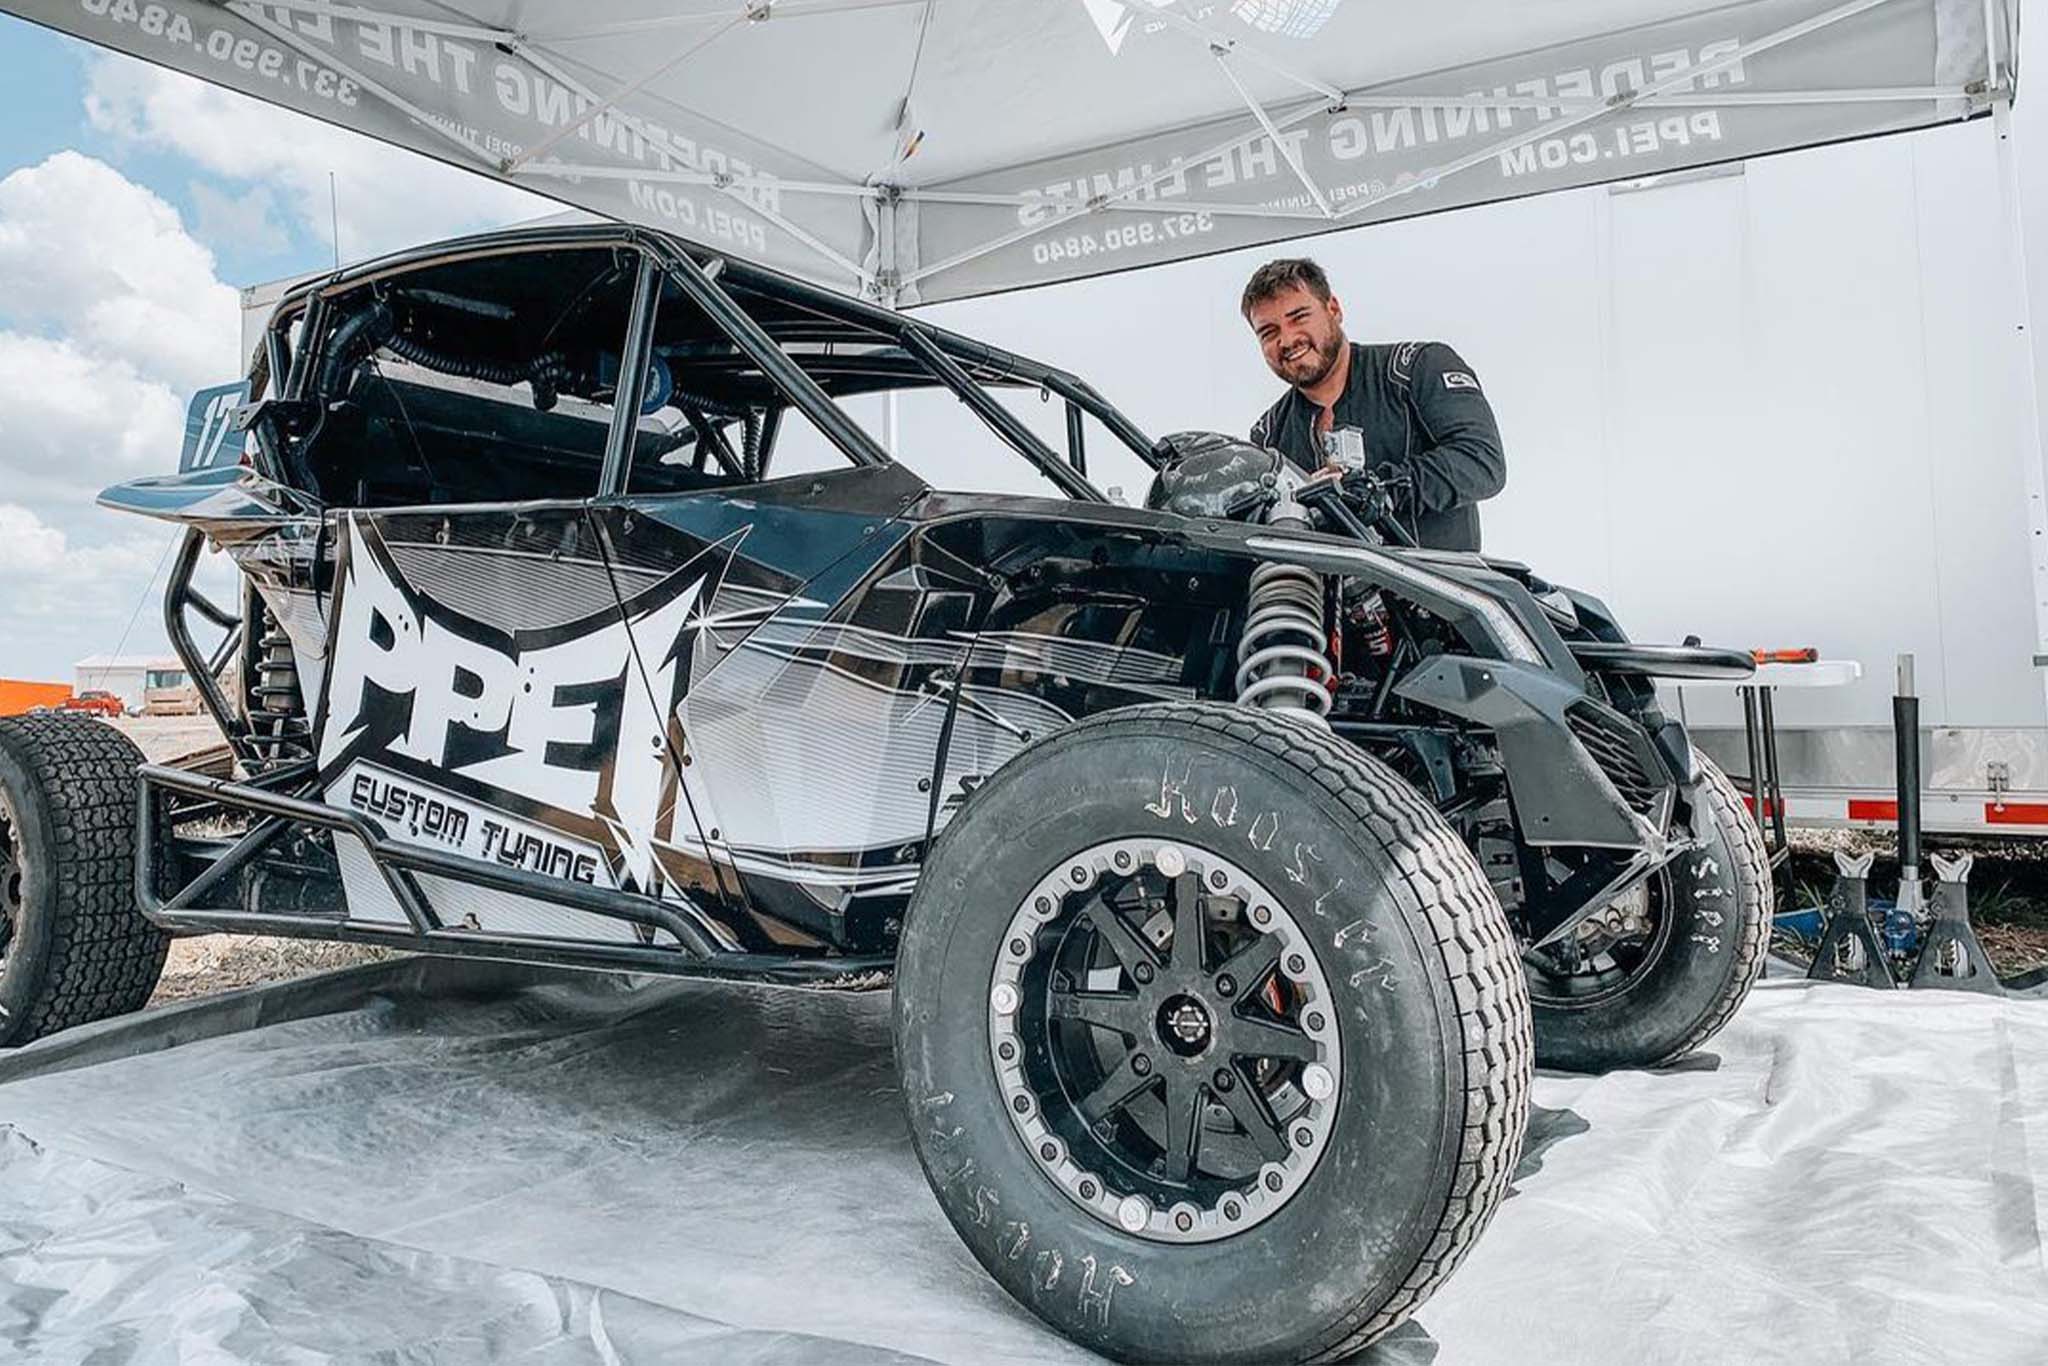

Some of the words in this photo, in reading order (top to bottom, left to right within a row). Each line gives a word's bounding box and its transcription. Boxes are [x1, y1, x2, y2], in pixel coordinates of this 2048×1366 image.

[191, 391, 232, 468] 17
[317, 511, 710, 895] PPEI
[350, 773, 469, 846] CUSTOM
[482, 818, 599, 884] TUNING
